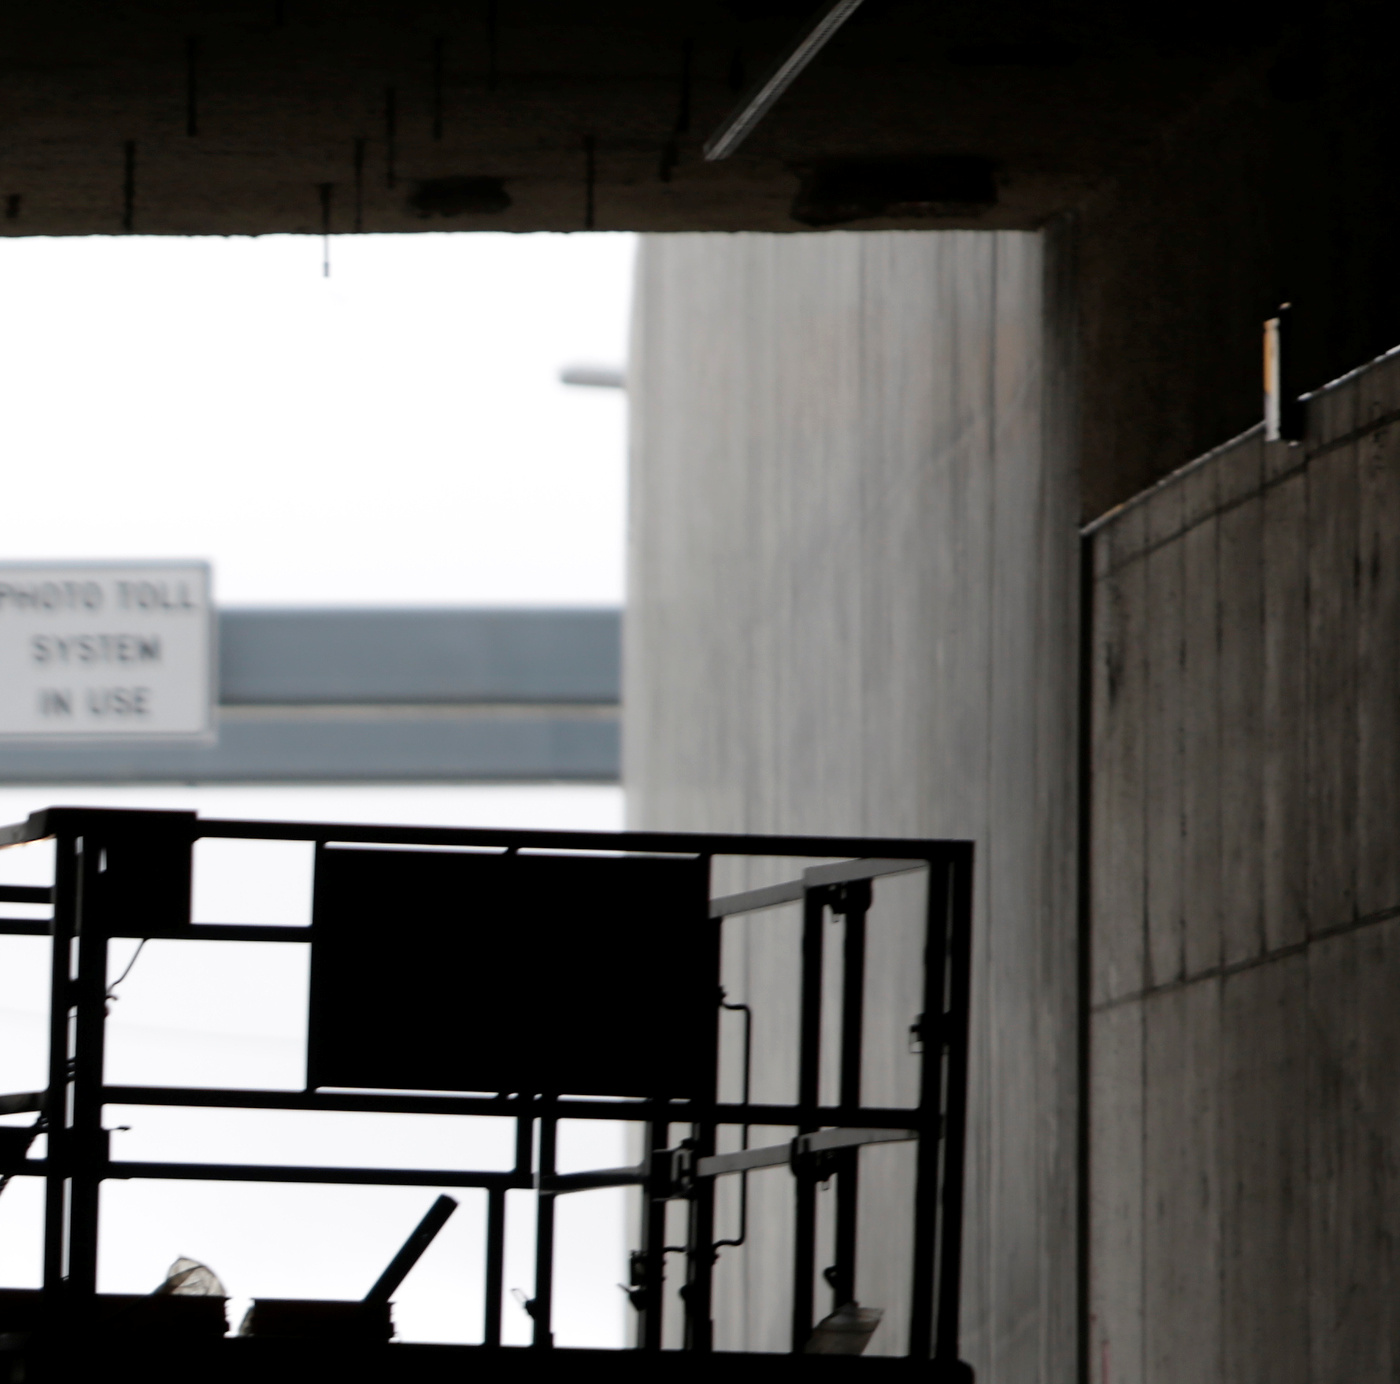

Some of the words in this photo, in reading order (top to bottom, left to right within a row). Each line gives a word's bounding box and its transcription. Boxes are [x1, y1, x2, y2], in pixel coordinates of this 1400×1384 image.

[115, 579, 196, 609] TOLL
[31, 634, 160, 664] SYSTEM
[39, 688, 72, 717] IN
[86, 687, 153, 716] USE
